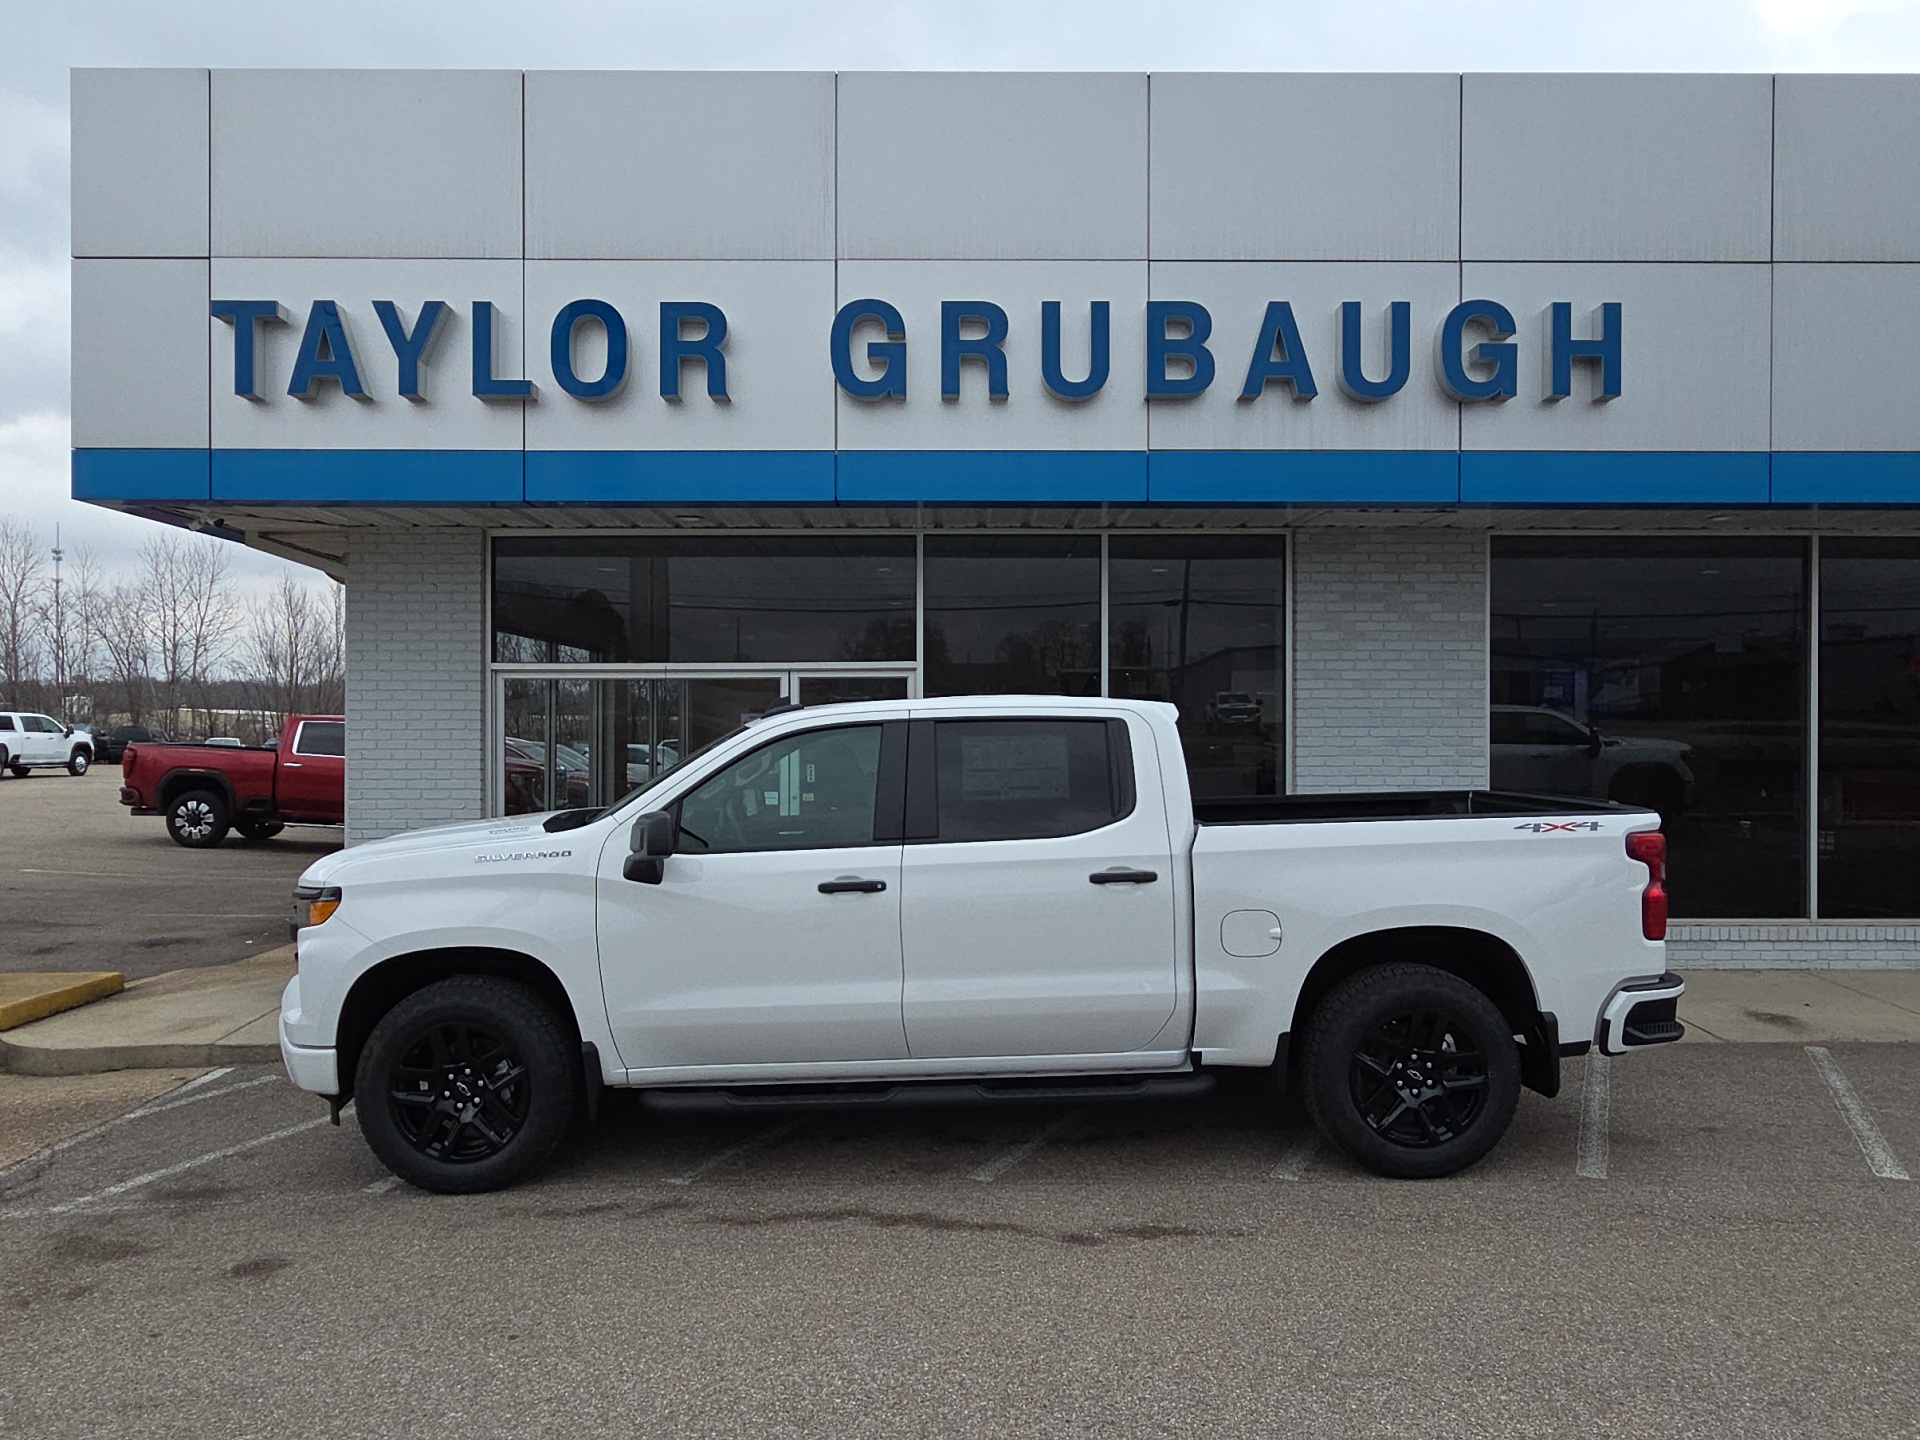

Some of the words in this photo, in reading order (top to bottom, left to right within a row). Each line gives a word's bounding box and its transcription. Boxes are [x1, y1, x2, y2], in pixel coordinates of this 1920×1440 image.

[210, 298, 732, 404] TAYLOR
[829, 298, 1624, 403] GRUBAUGH
[474, 850, 572, 863] SILVERADO
